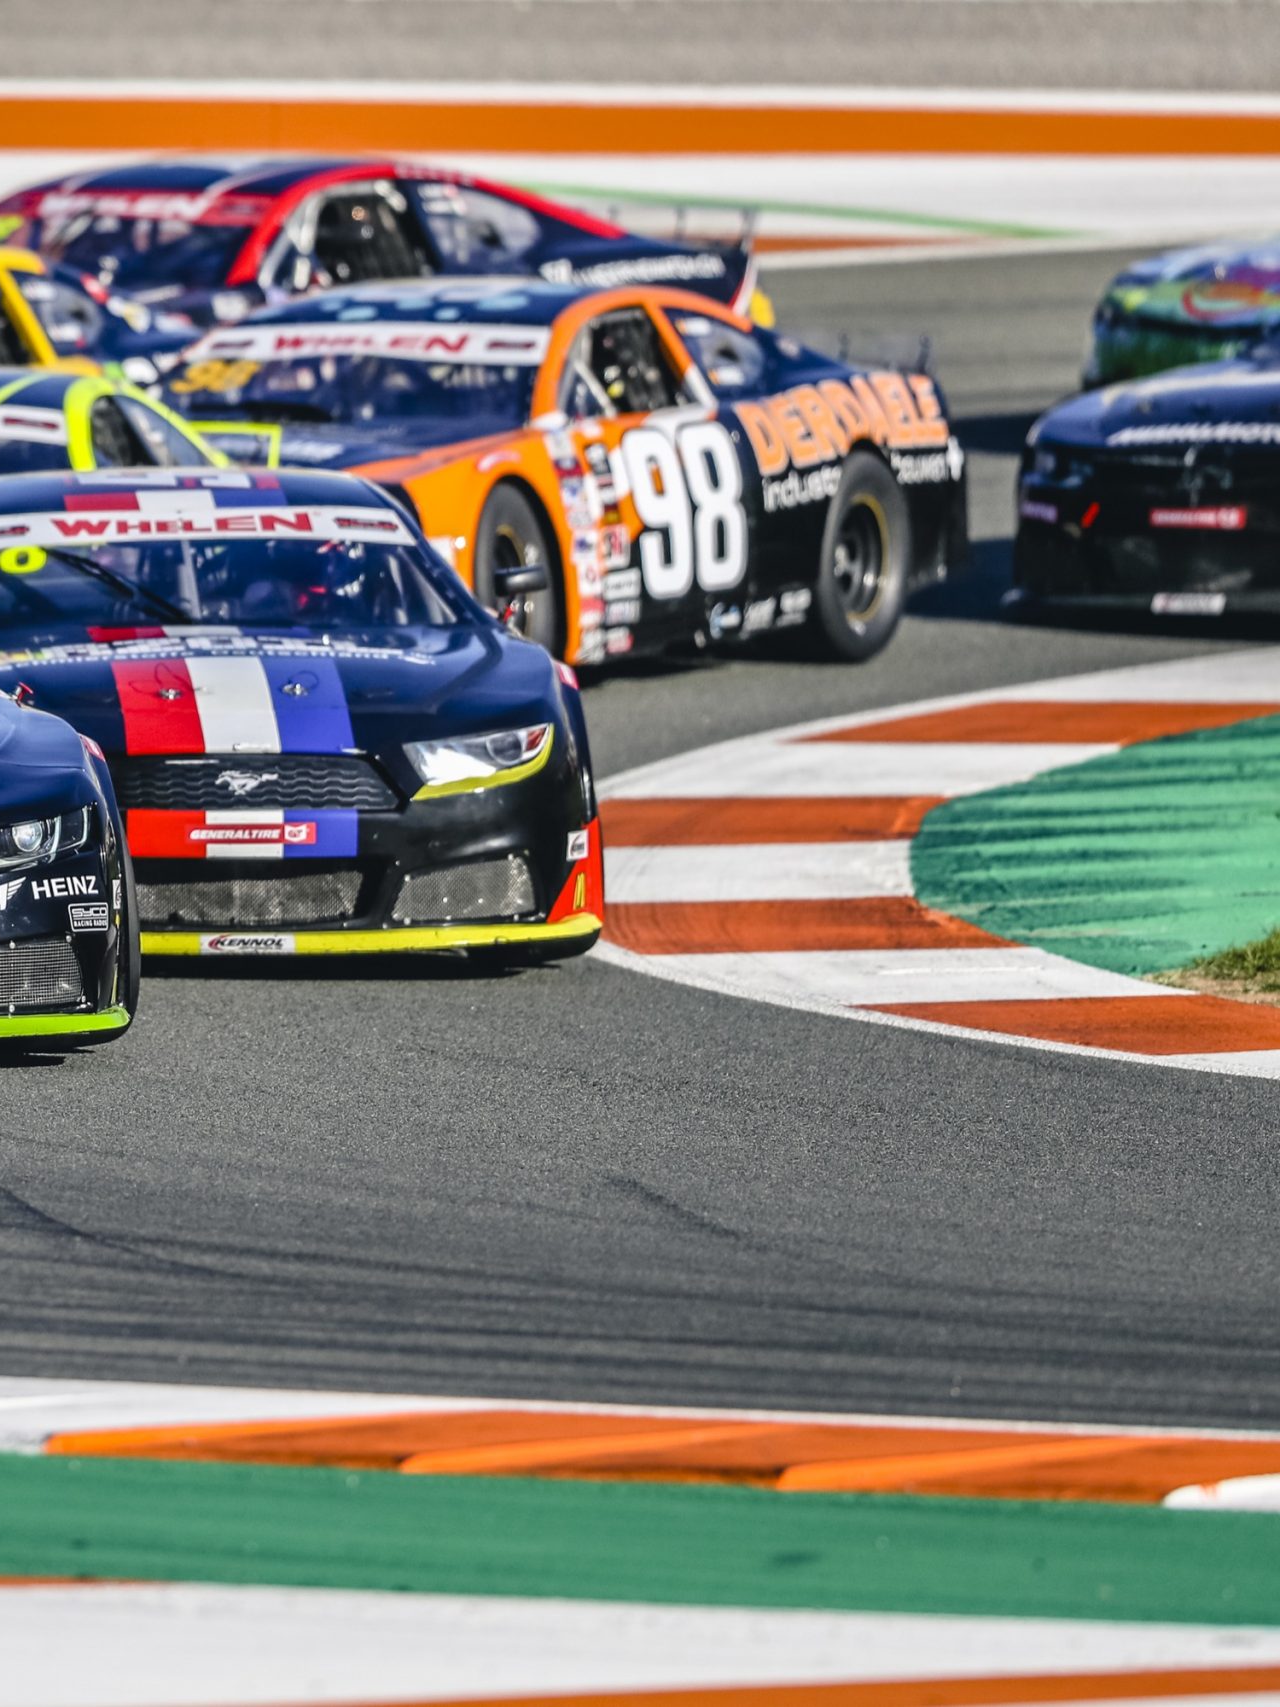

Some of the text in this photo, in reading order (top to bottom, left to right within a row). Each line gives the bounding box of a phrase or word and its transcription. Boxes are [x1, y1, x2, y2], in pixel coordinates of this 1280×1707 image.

[621, 421, 748, 599] 98
[51, 512, 315, 538] WHELEN
[30, 875, 99, 900] HEINZ
[215, 937, 284, 947] KENNOL
